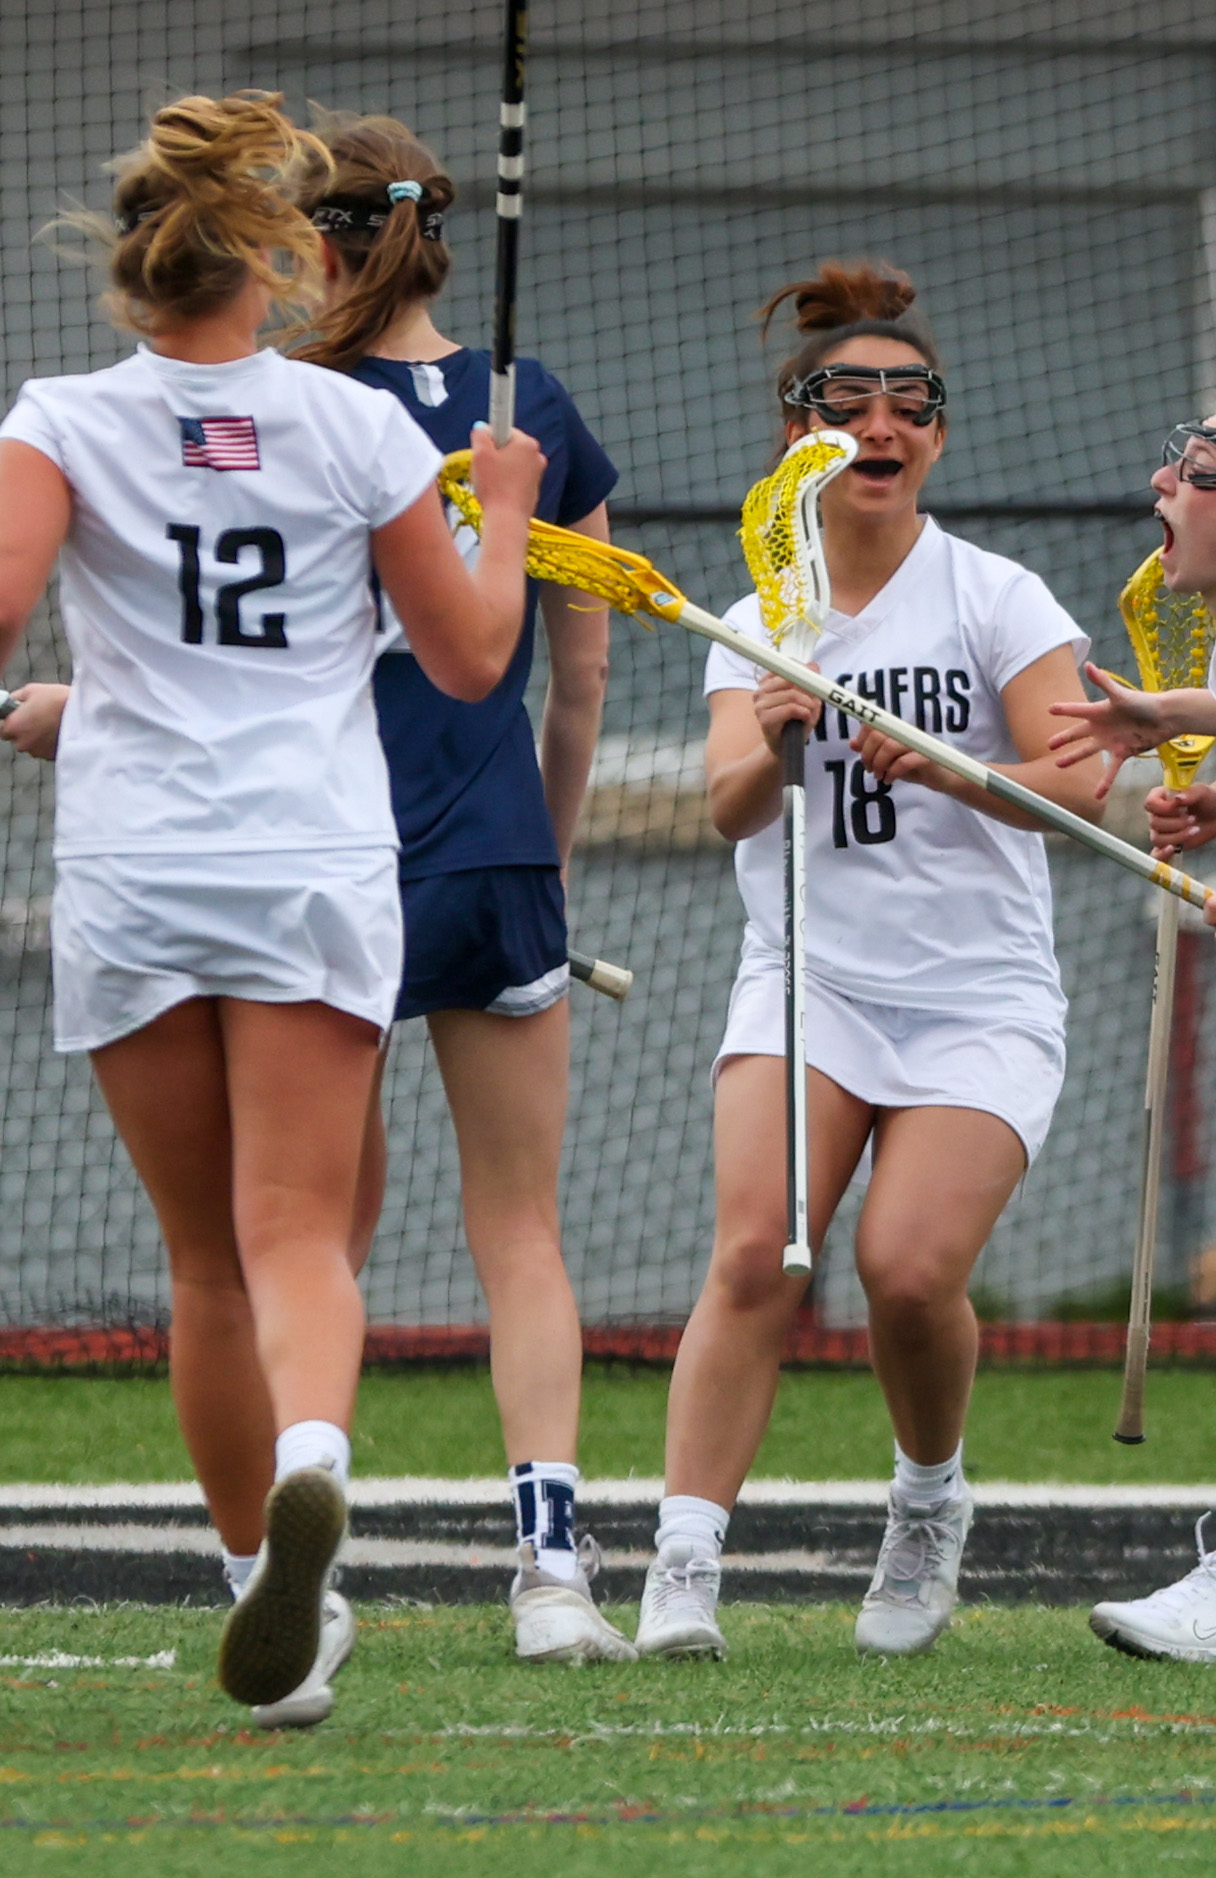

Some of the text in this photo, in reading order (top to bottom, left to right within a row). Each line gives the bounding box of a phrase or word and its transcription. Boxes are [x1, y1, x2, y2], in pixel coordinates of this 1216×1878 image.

[166, 523, 288, 648] 12
[827, 689, 881, 723] GAIT
[824, 759, 897, 849] 18
